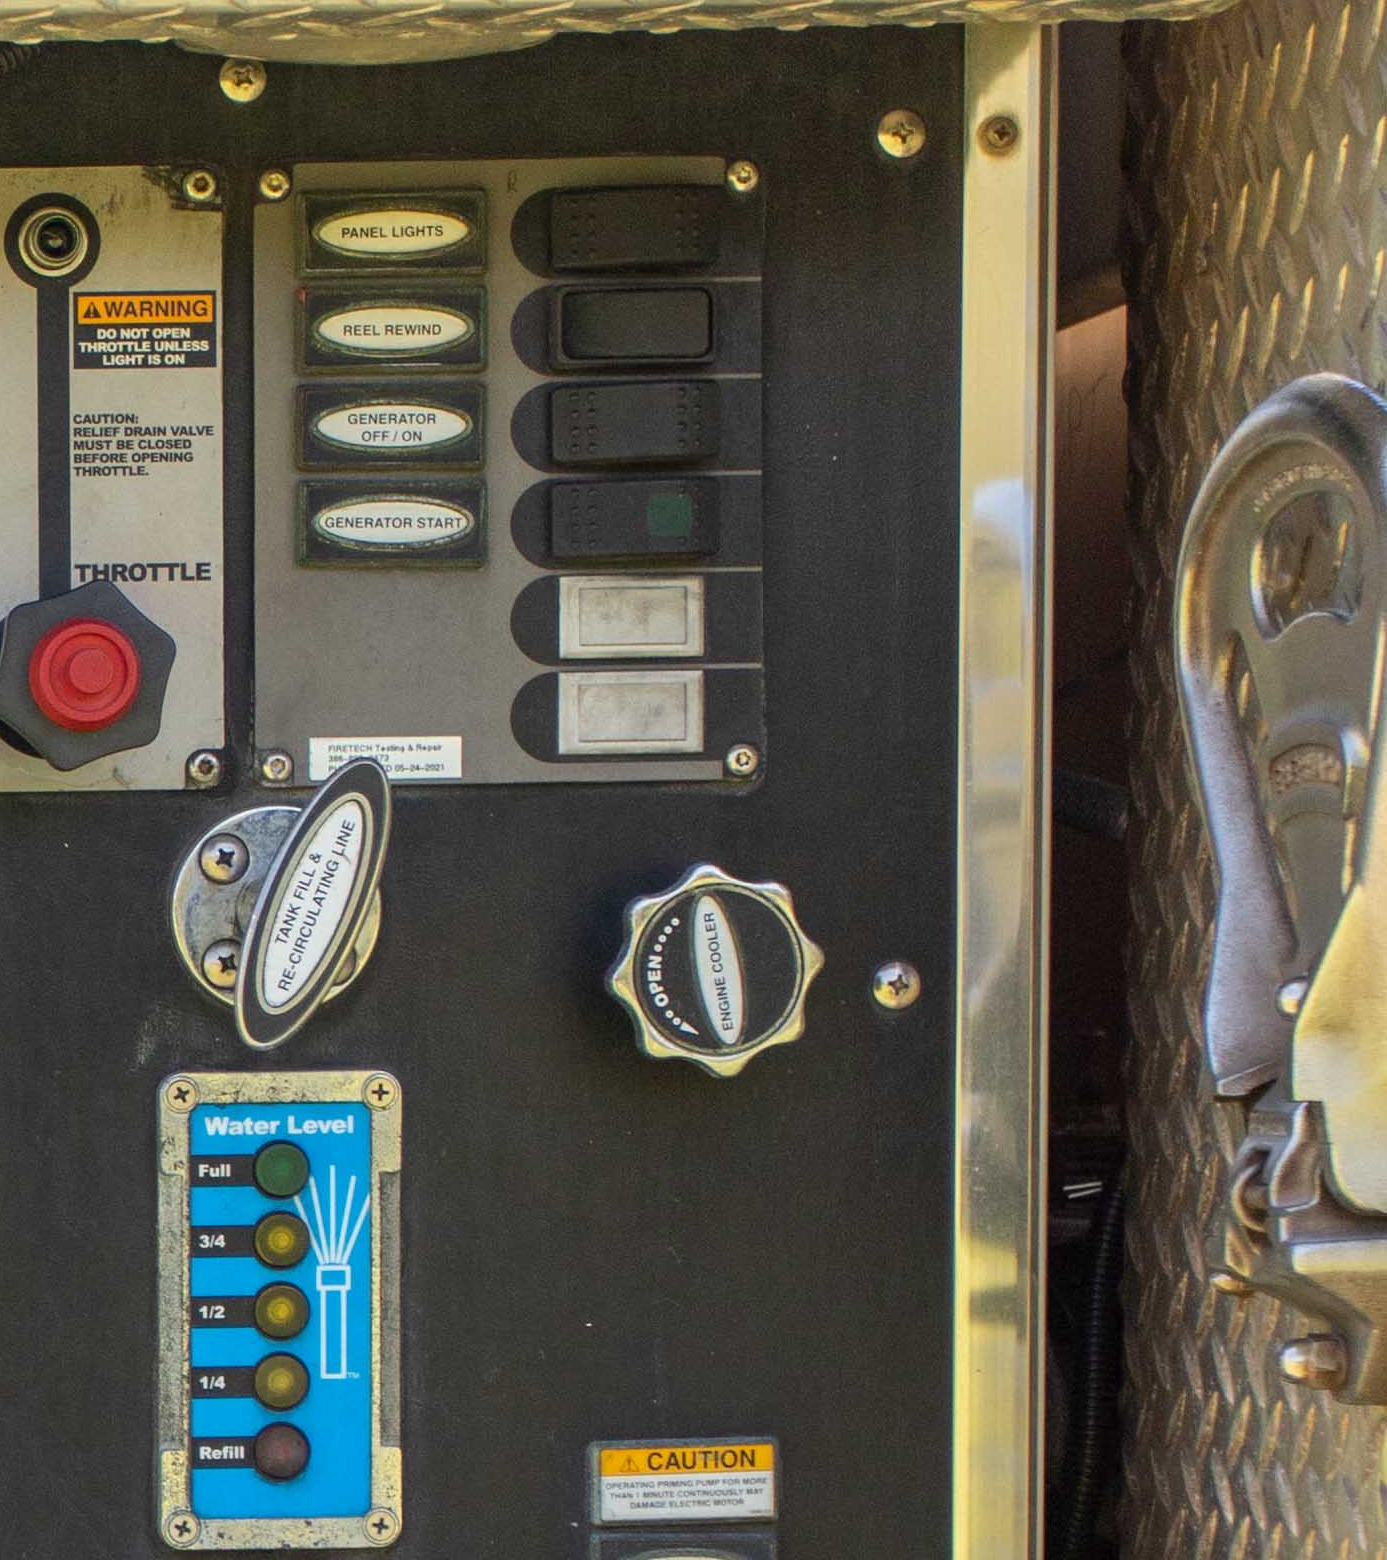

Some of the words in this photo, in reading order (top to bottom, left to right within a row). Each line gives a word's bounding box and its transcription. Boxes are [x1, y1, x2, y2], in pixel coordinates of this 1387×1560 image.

[341, 227, 387, 240] PANEL
[392, 225, 443, 237] LIGHTS
[104, 298, 207, 318] WARNING
[97, 329, 117, 340] DO
[120, 329, 149, 339] NOT
[152, 328, 190, 339] OPEN
[343, 324, 379, 336] REEL
[384, 324, 442, 336] REWIND
[79, 342, 151, 353] THROTTLE
[154, 341, 210, 352] UNLESS
[103, 355, 144, 366] LIGHT
[148, 354, 161, 365] IS
[165, 354, 185, 365] ON
[348, 414, 436, 426] GENERATOR
[325, 518, 412, 530] GENERATOR
[417, 517, 461, 529] START
[75, 563, 211, 582] THROTTLE
[704, 912, 723, 973] COOLER
[648, 955, 668, 1007] OPEN
[714, 975, 734, 1031] ENGINE
[205, 1116, 279, 1136] Water
[288, 1115, 354, 1134] Level
[198, 1164, 231, 1177] Full
[199, 1446, 245, 1459] Refill
[647, 1450, 756, 1471] CAUTION
